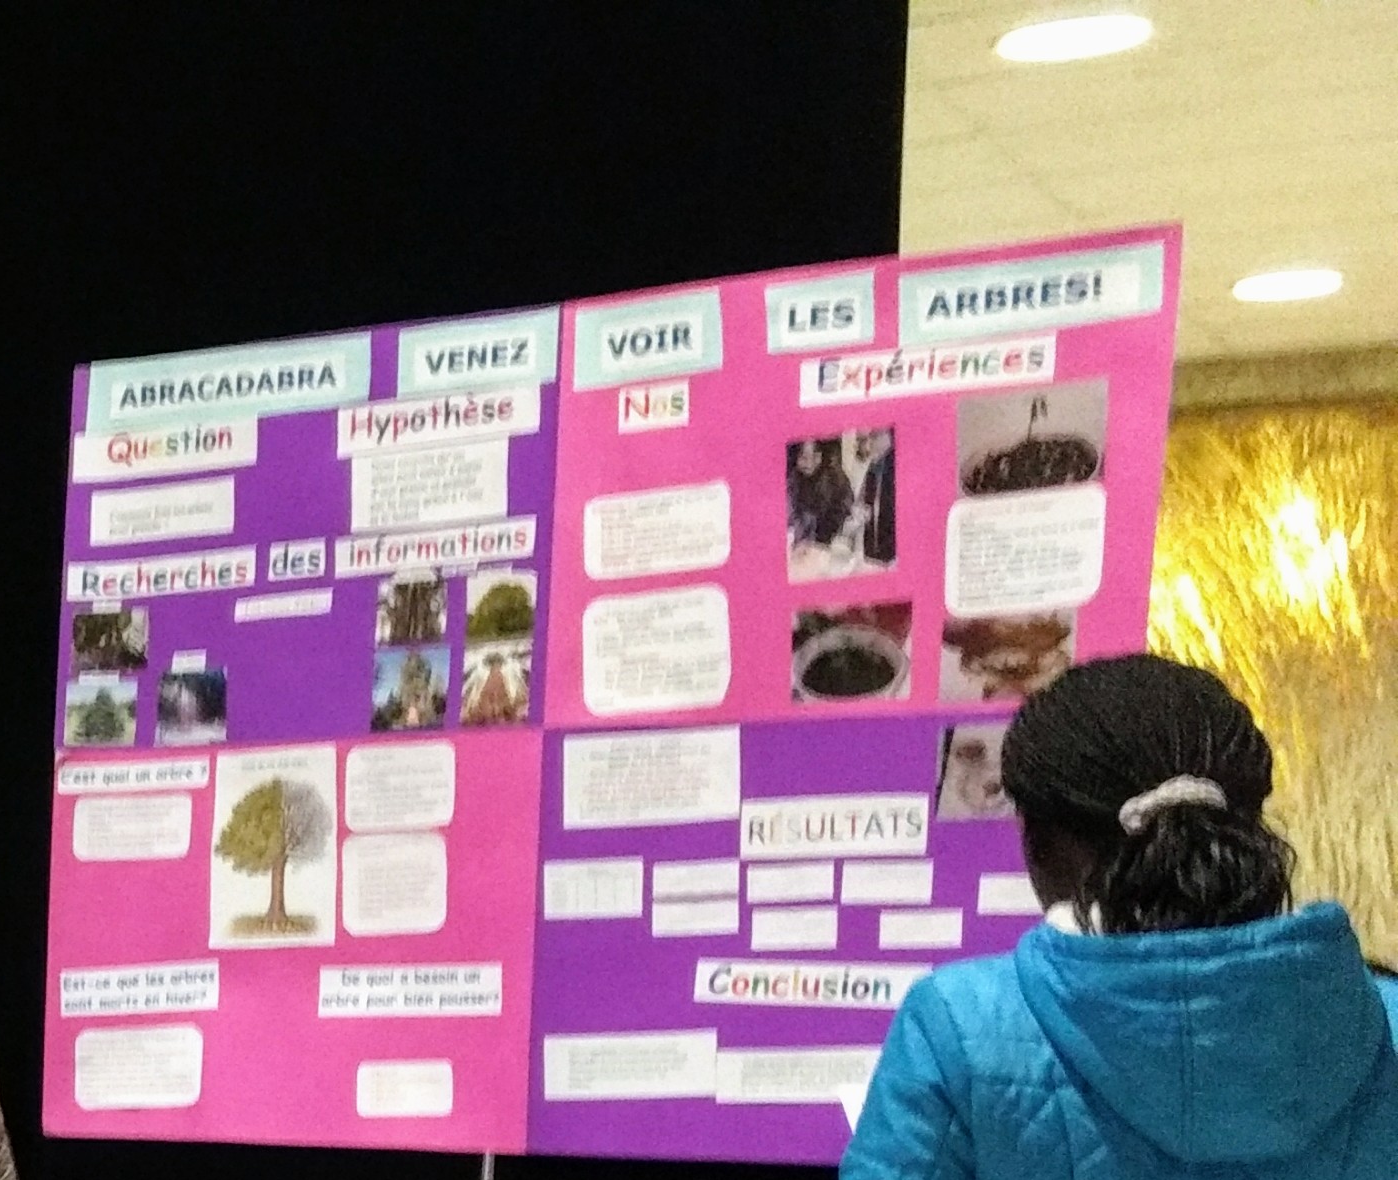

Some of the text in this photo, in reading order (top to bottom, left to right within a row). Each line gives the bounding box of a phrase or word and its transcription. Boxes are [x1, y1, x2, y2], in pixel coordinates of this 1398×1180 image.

[607, 269, 1103, 361] VOIR LES ARBRES!
[118, 338, 530, 411] ABRACADABRA VENEZ
[622, 344, 1045, 421] Nos Expériences
[107, 424, 233, 467] Question
[350, 391, 514, 444] Hypothèse
[81, 524, 527, 596] Recherches des informations
[708, 965, 891, 1002] Conclusion
